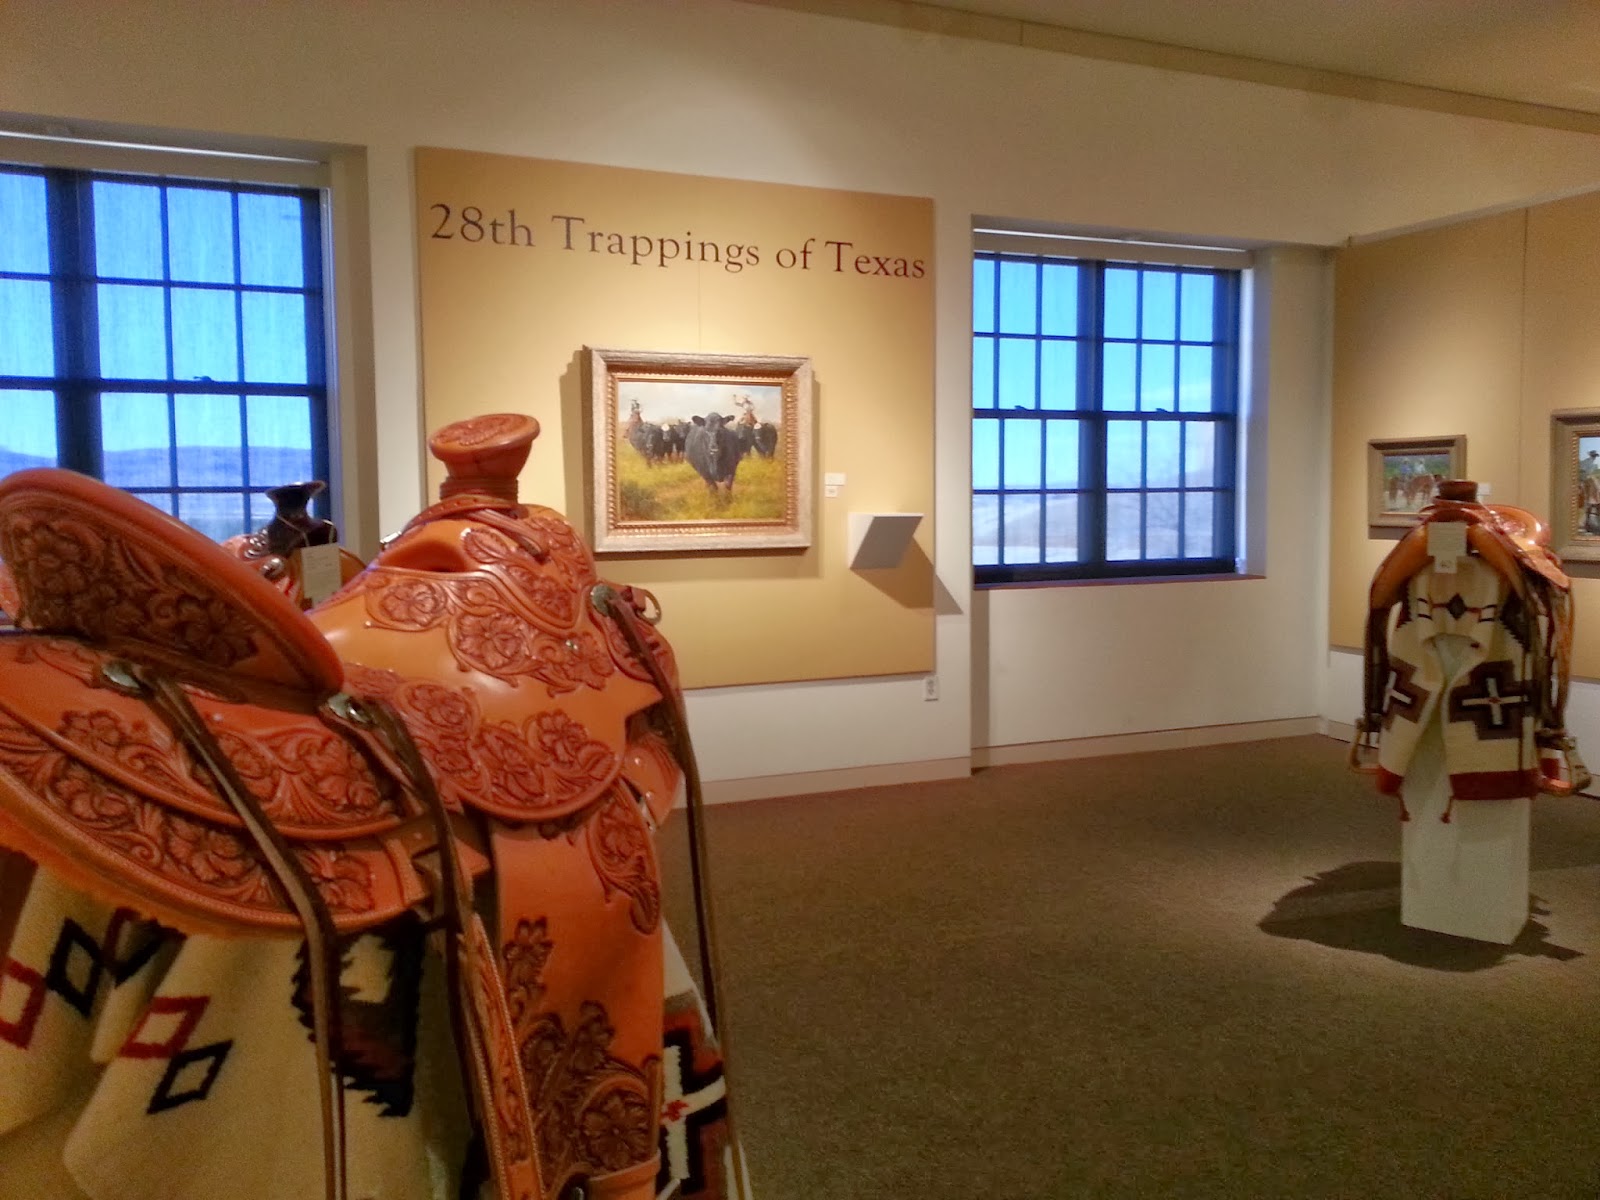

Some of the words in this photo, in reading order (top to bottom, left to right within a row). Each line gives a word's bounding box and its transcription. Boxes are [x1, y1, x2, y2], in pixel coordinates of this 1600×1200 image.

[430, 203, 535, 247] 28th
[551, 215, 760, 272] Trappings
[776, 238, 817, 270] of
[825, 241, 926, 279] Texas
